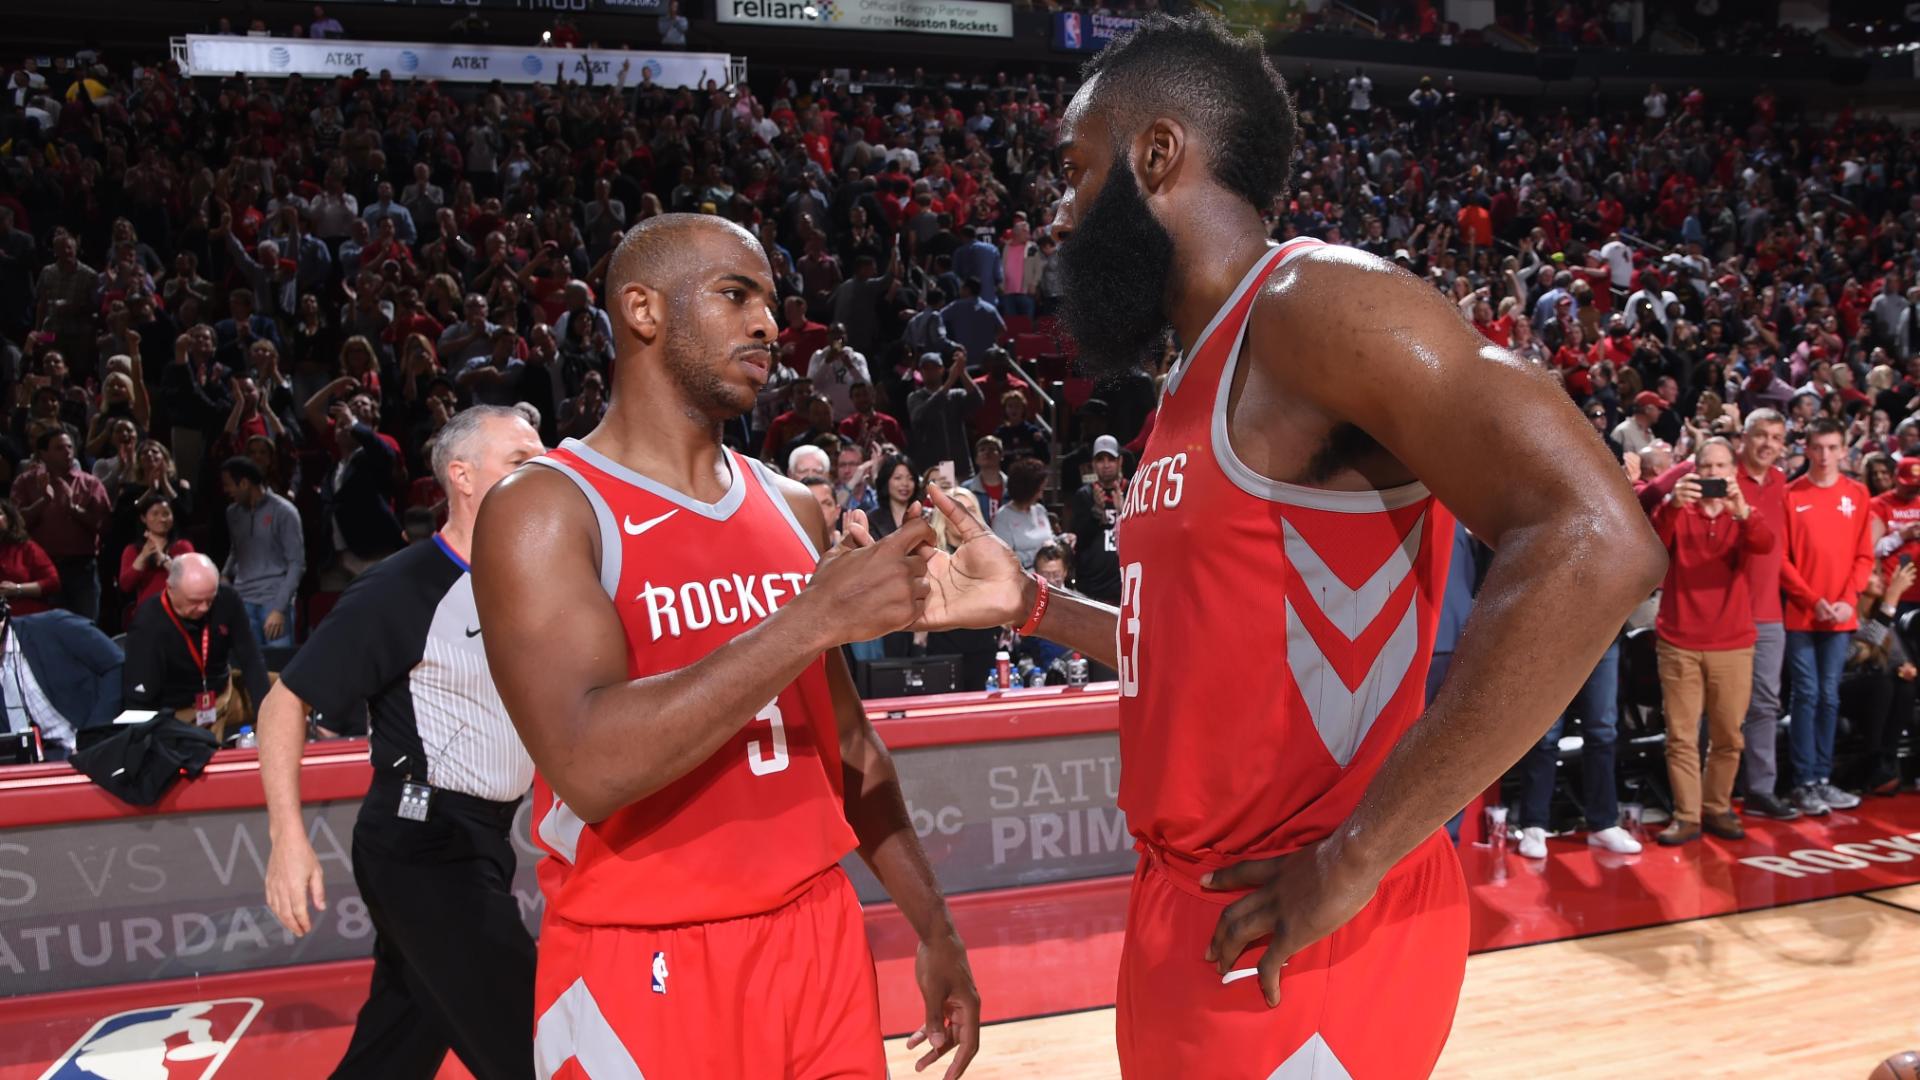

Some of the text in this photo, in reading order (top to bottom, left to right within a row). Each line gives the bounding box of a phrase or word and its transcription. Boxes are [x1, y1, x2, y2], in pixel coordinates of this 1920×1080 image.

[894, 15, 947, 30] Houston
[949, 19, 998, 33] Rockets
[325, 51, 364, 66] AT&T
[452, 55, 490, 71] AT&T
[635, 572, 814, 643] ROCKET
[746, 695, 790, 777] 3
[1737, 832, 1920, 878] ROCK
